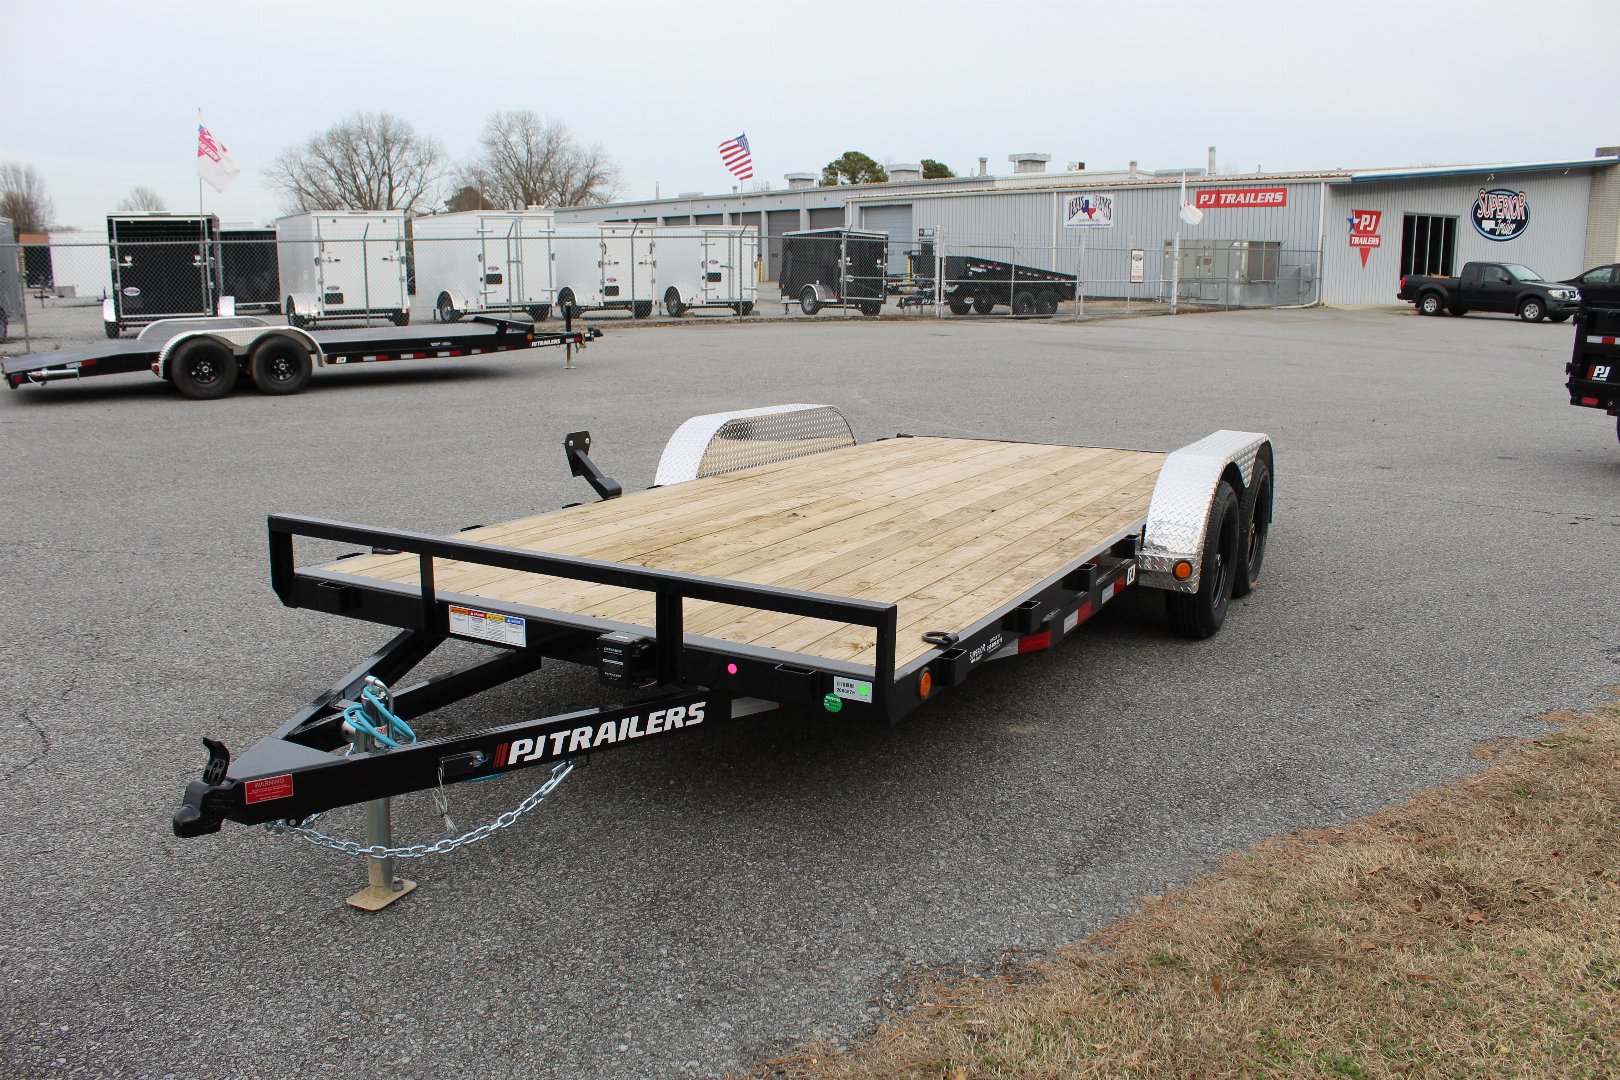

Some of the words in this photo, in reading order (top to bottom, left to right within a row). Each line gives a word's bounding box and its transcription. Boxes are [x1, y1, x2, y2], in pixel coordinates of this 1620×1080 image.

[1199, 194, 1217, 205] PJ
[1219, 191, 1284, 204] TRAILERS
[1477, 188, 1526, 220] SUPERIOR
[1359, 214, 1377, 231] PJ
[1351, 236, 1380, 245] TRAILERS
[1592, 365, 1611, 378] PJ
[508, 735, 547, 766] PJ
[549, 701, 707, 756] TRAILERS
[255, 777, 285, 788] WARNING
